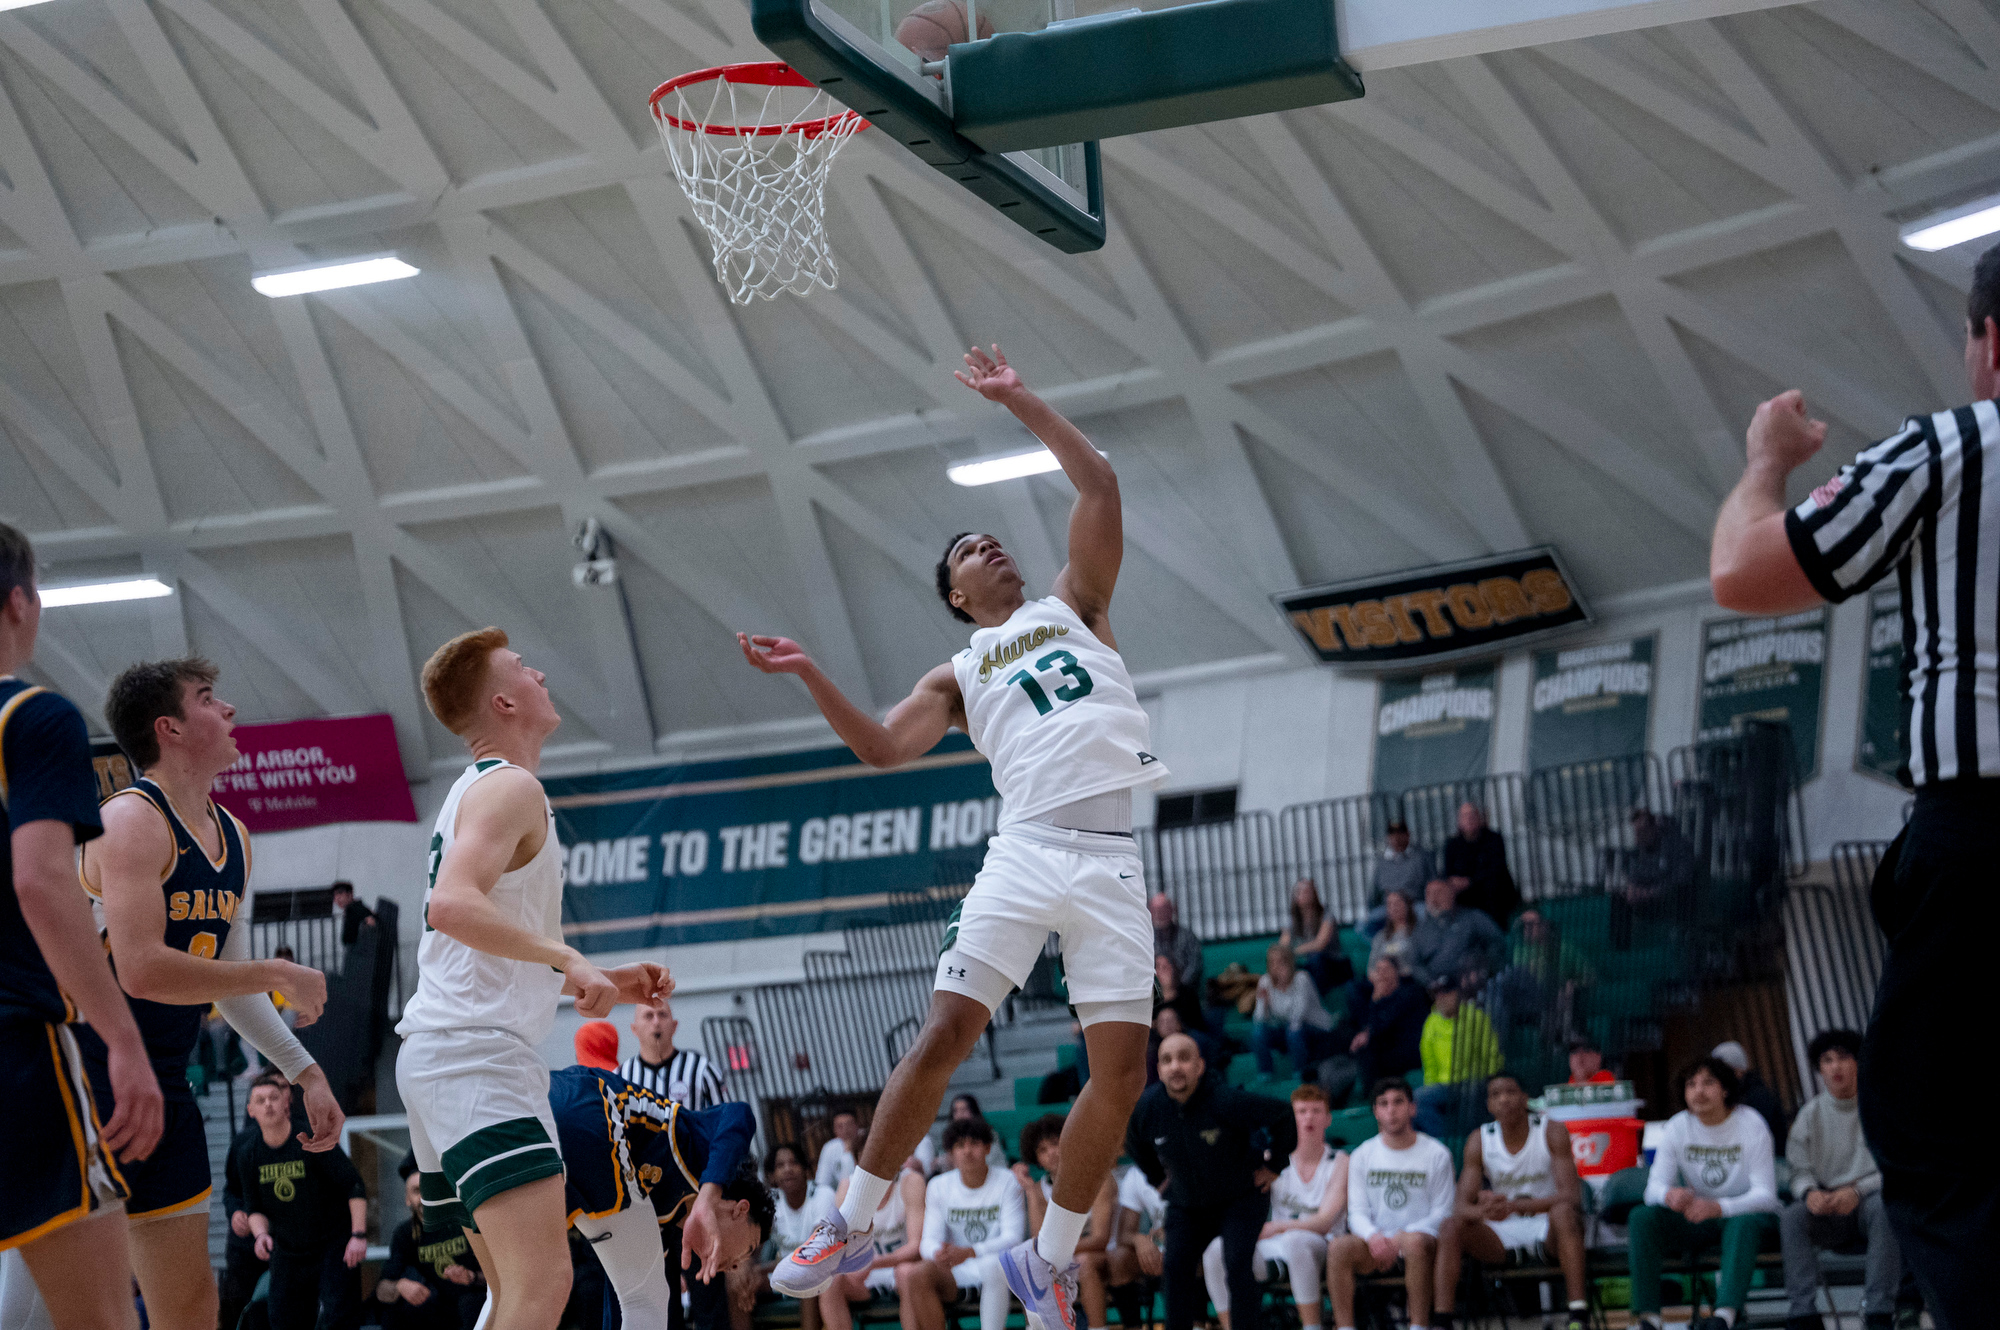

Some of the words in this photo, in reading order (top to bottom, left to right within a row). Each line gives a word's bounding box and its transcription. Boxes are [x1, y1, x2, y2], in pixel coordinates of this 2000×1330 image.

[1293, 567, 1573, 650] VISITORS
[979, 624, 1069, 684] Huron
[1007, 650, 1094, 716] 13
[211, 772, 259, 793] E'RE
[260, 767, 313, 789] WITH
[313, 764, 357, 785] YOU
[256, 746, 332, 770] ARBOR,
[661, 830, 708, 877] TO
[720, 821, 790, 872] THE
[799, 807, 921, 864] GREEN
